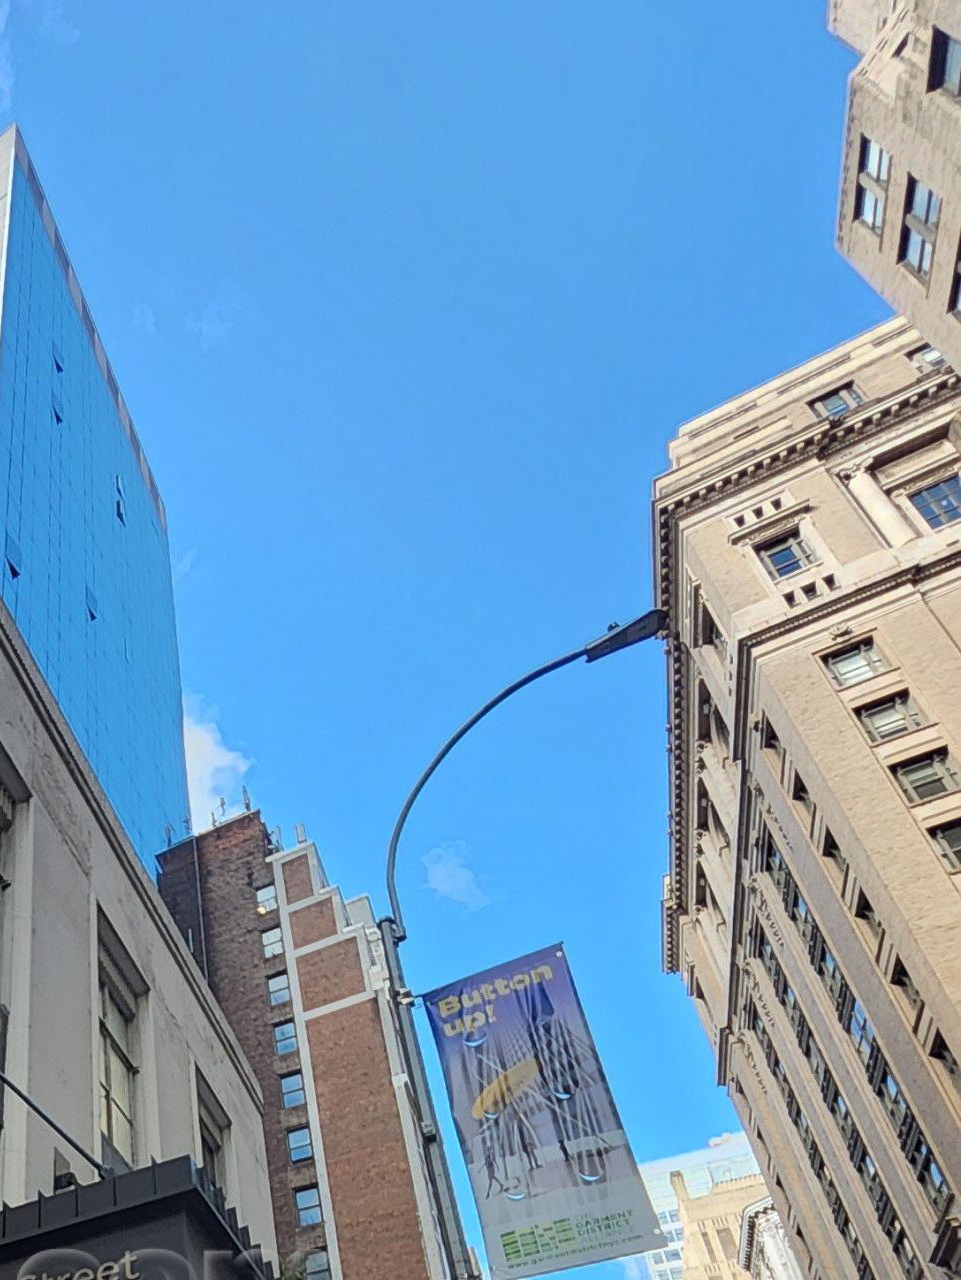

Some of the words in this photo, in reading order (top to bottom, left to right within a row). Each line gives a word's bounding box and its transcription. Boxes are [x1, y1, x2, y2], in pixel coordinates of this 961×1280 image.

[438, 965, 553, 1018] Button
[444, 1004, 497, 1037] up!
[576, 1209, 634, 1229] GARMENT
[578, 1219, 631, 1237] DISTRICT
